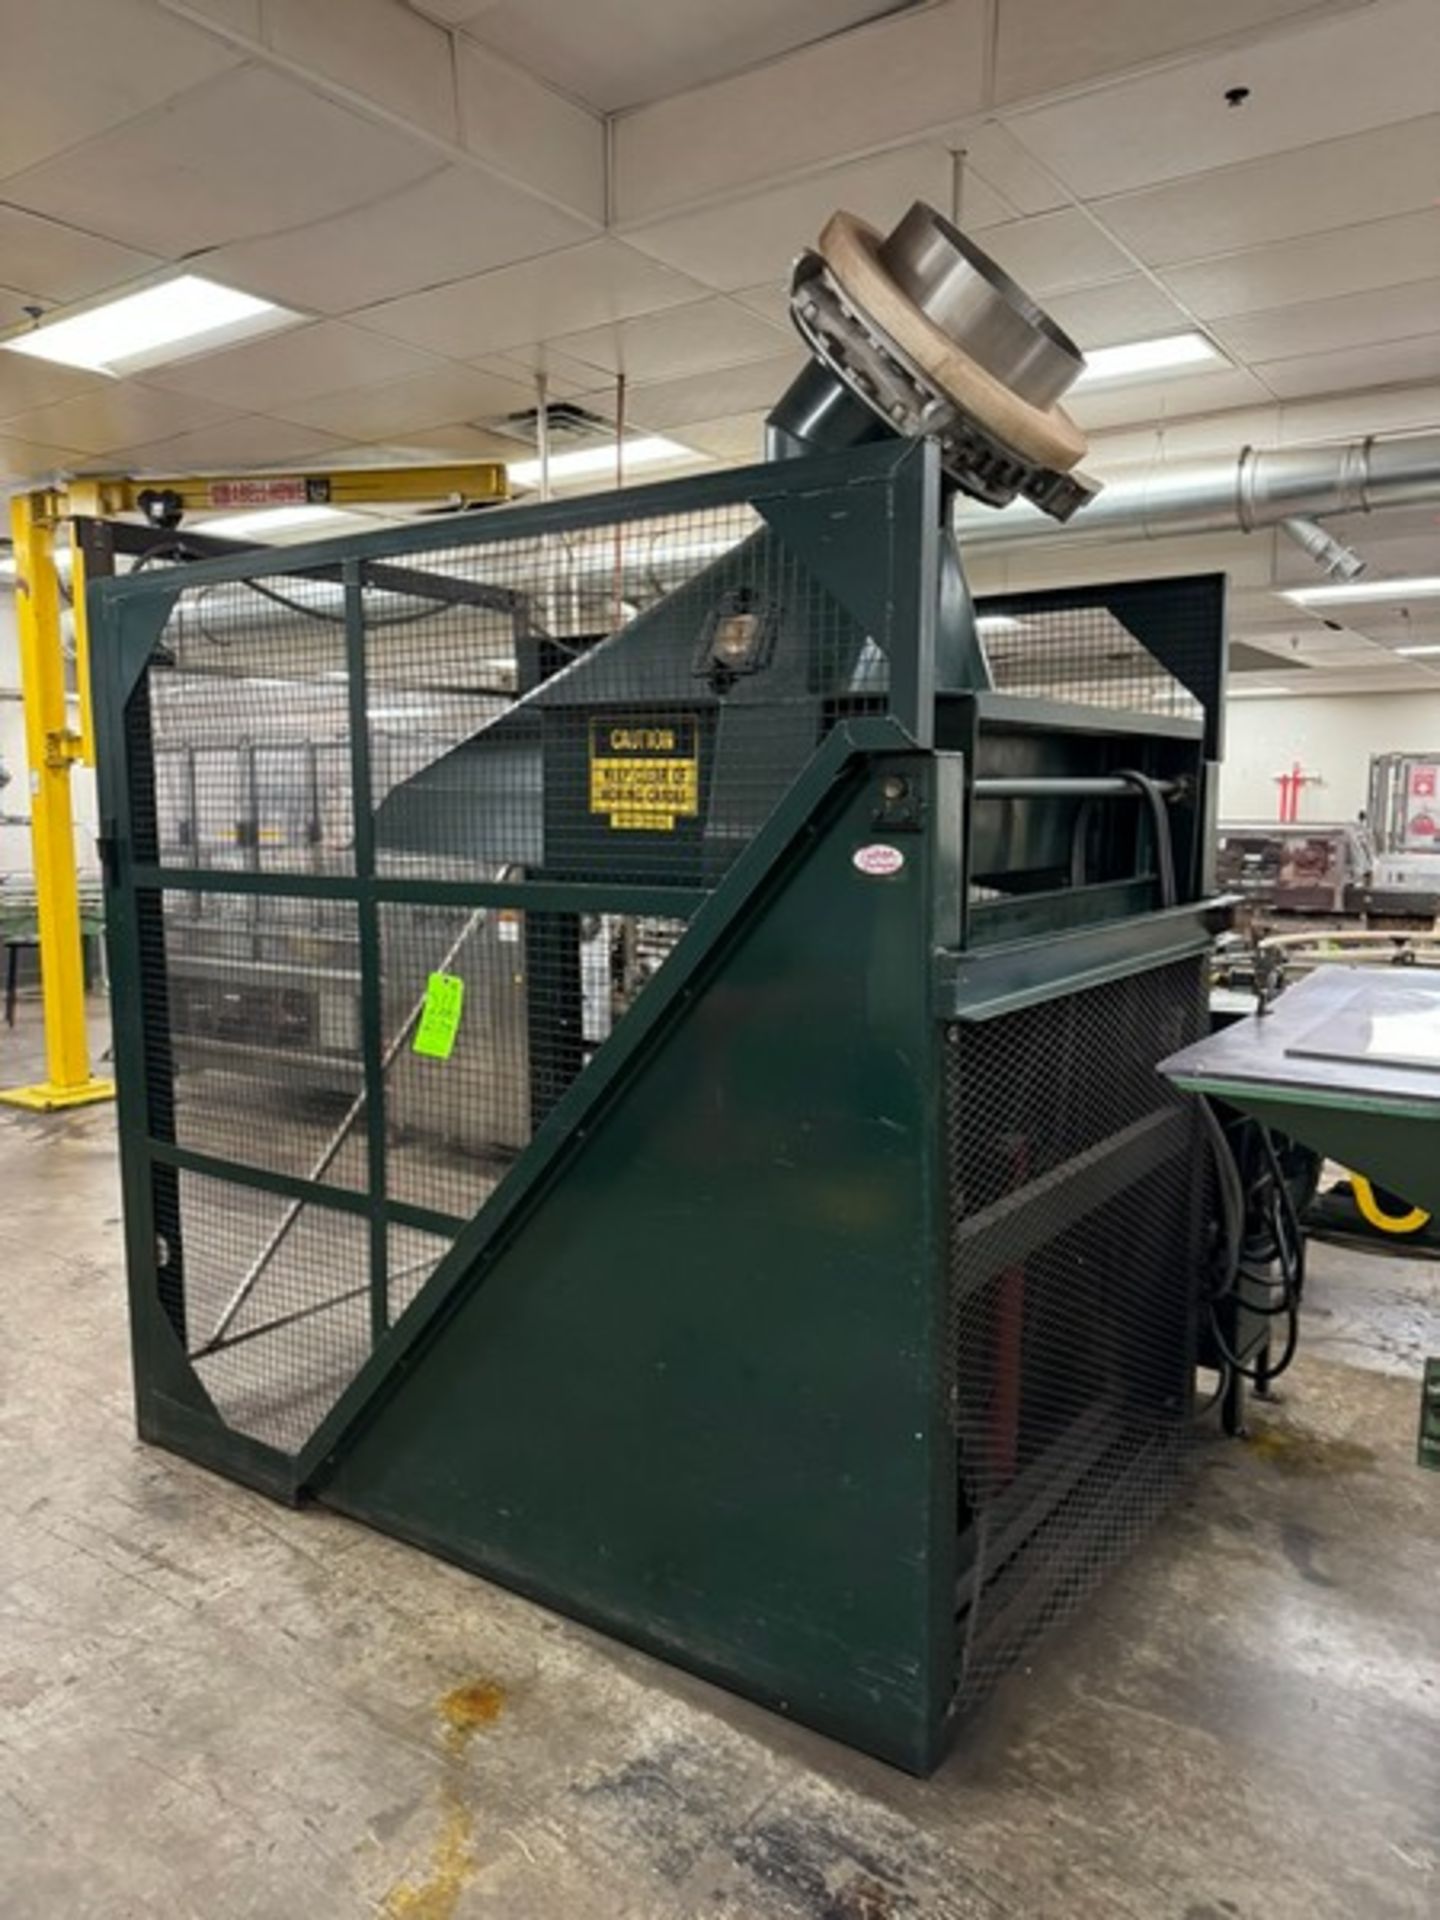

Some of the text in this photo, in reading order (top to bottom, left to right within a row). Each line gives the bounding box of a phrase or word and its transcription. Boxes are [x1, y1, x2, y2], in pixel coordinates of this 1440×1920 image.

[610, 729, 674, 750] CAUTION
[603, 767, 631, 783] KEEP
[672, 768, 687, 784] OF
